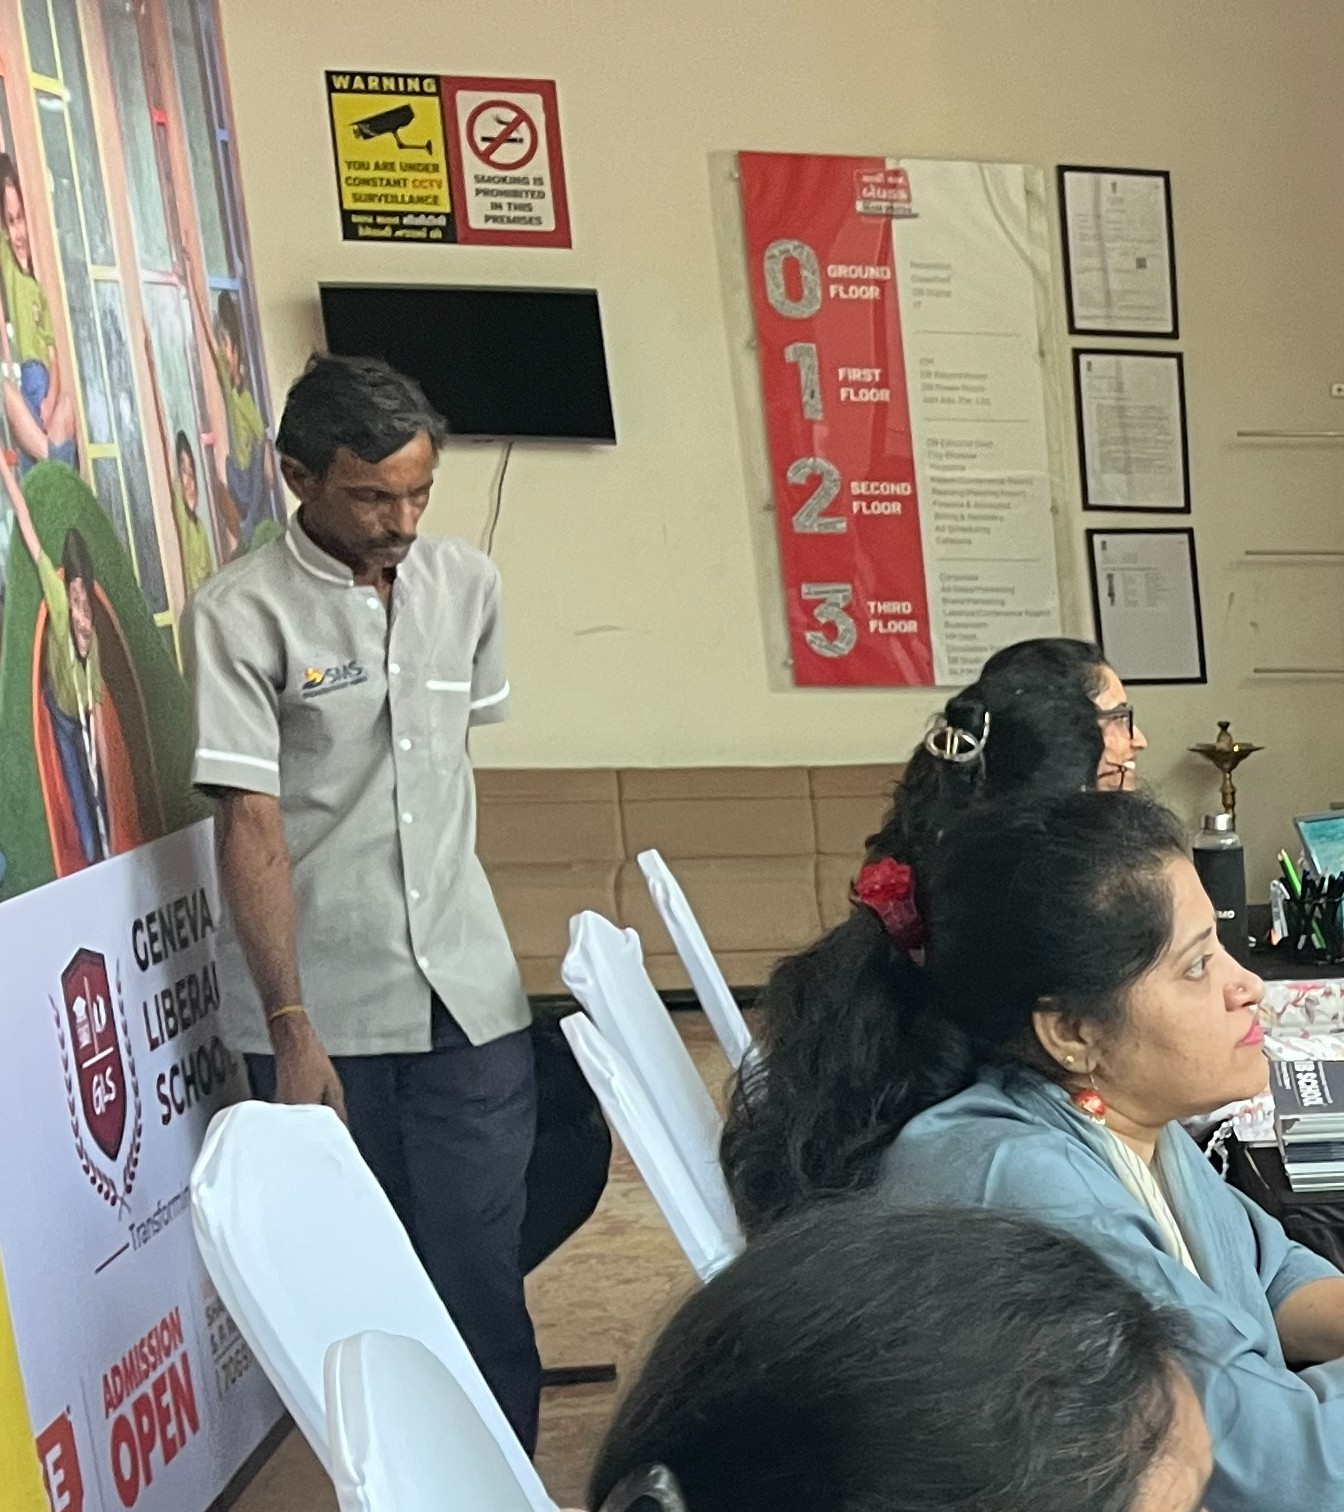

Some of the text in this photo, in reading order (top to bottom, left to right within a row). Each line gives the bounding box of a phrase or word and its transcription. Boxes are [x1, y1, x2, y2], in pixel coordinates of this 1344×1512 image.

[332, 75, 437, 93] WARNING
[345, 161, 440, 173] YOU ARE UNDER
[345, 176, 443, 190] CONSTANT CCTV
[474, 174, 544, 186] SMOKING IS
[352, 193, 440, 206] SURVEILLANCE
[475, 188, 546, 200] PROHIBITED
[490, 201, 533, 213] IN THIS
[484, 213, 543, 226] PREMISES
[763, 238, 891, 319] 0 GROUND
[829, 285, 880, 299] FLOOR
[785, 342, 823, 421] 1
[838, 367, 882, 382] FIRST
[840, 387, 890, 402] FLOOR
[786, 457, 847, 533] 2
[850, 481, 912, 496] SECOND
[852, 499, 902, 516] FLOOR
[801, 582, 912, 658] 3 THIRD
[868, 619, 918, 634] FLOOR
[132, 888, 215, 972] GENEVA
[102, 1305, 184, 1420] ADMISSION
[111, 1350, 200, 1509] OPEN
